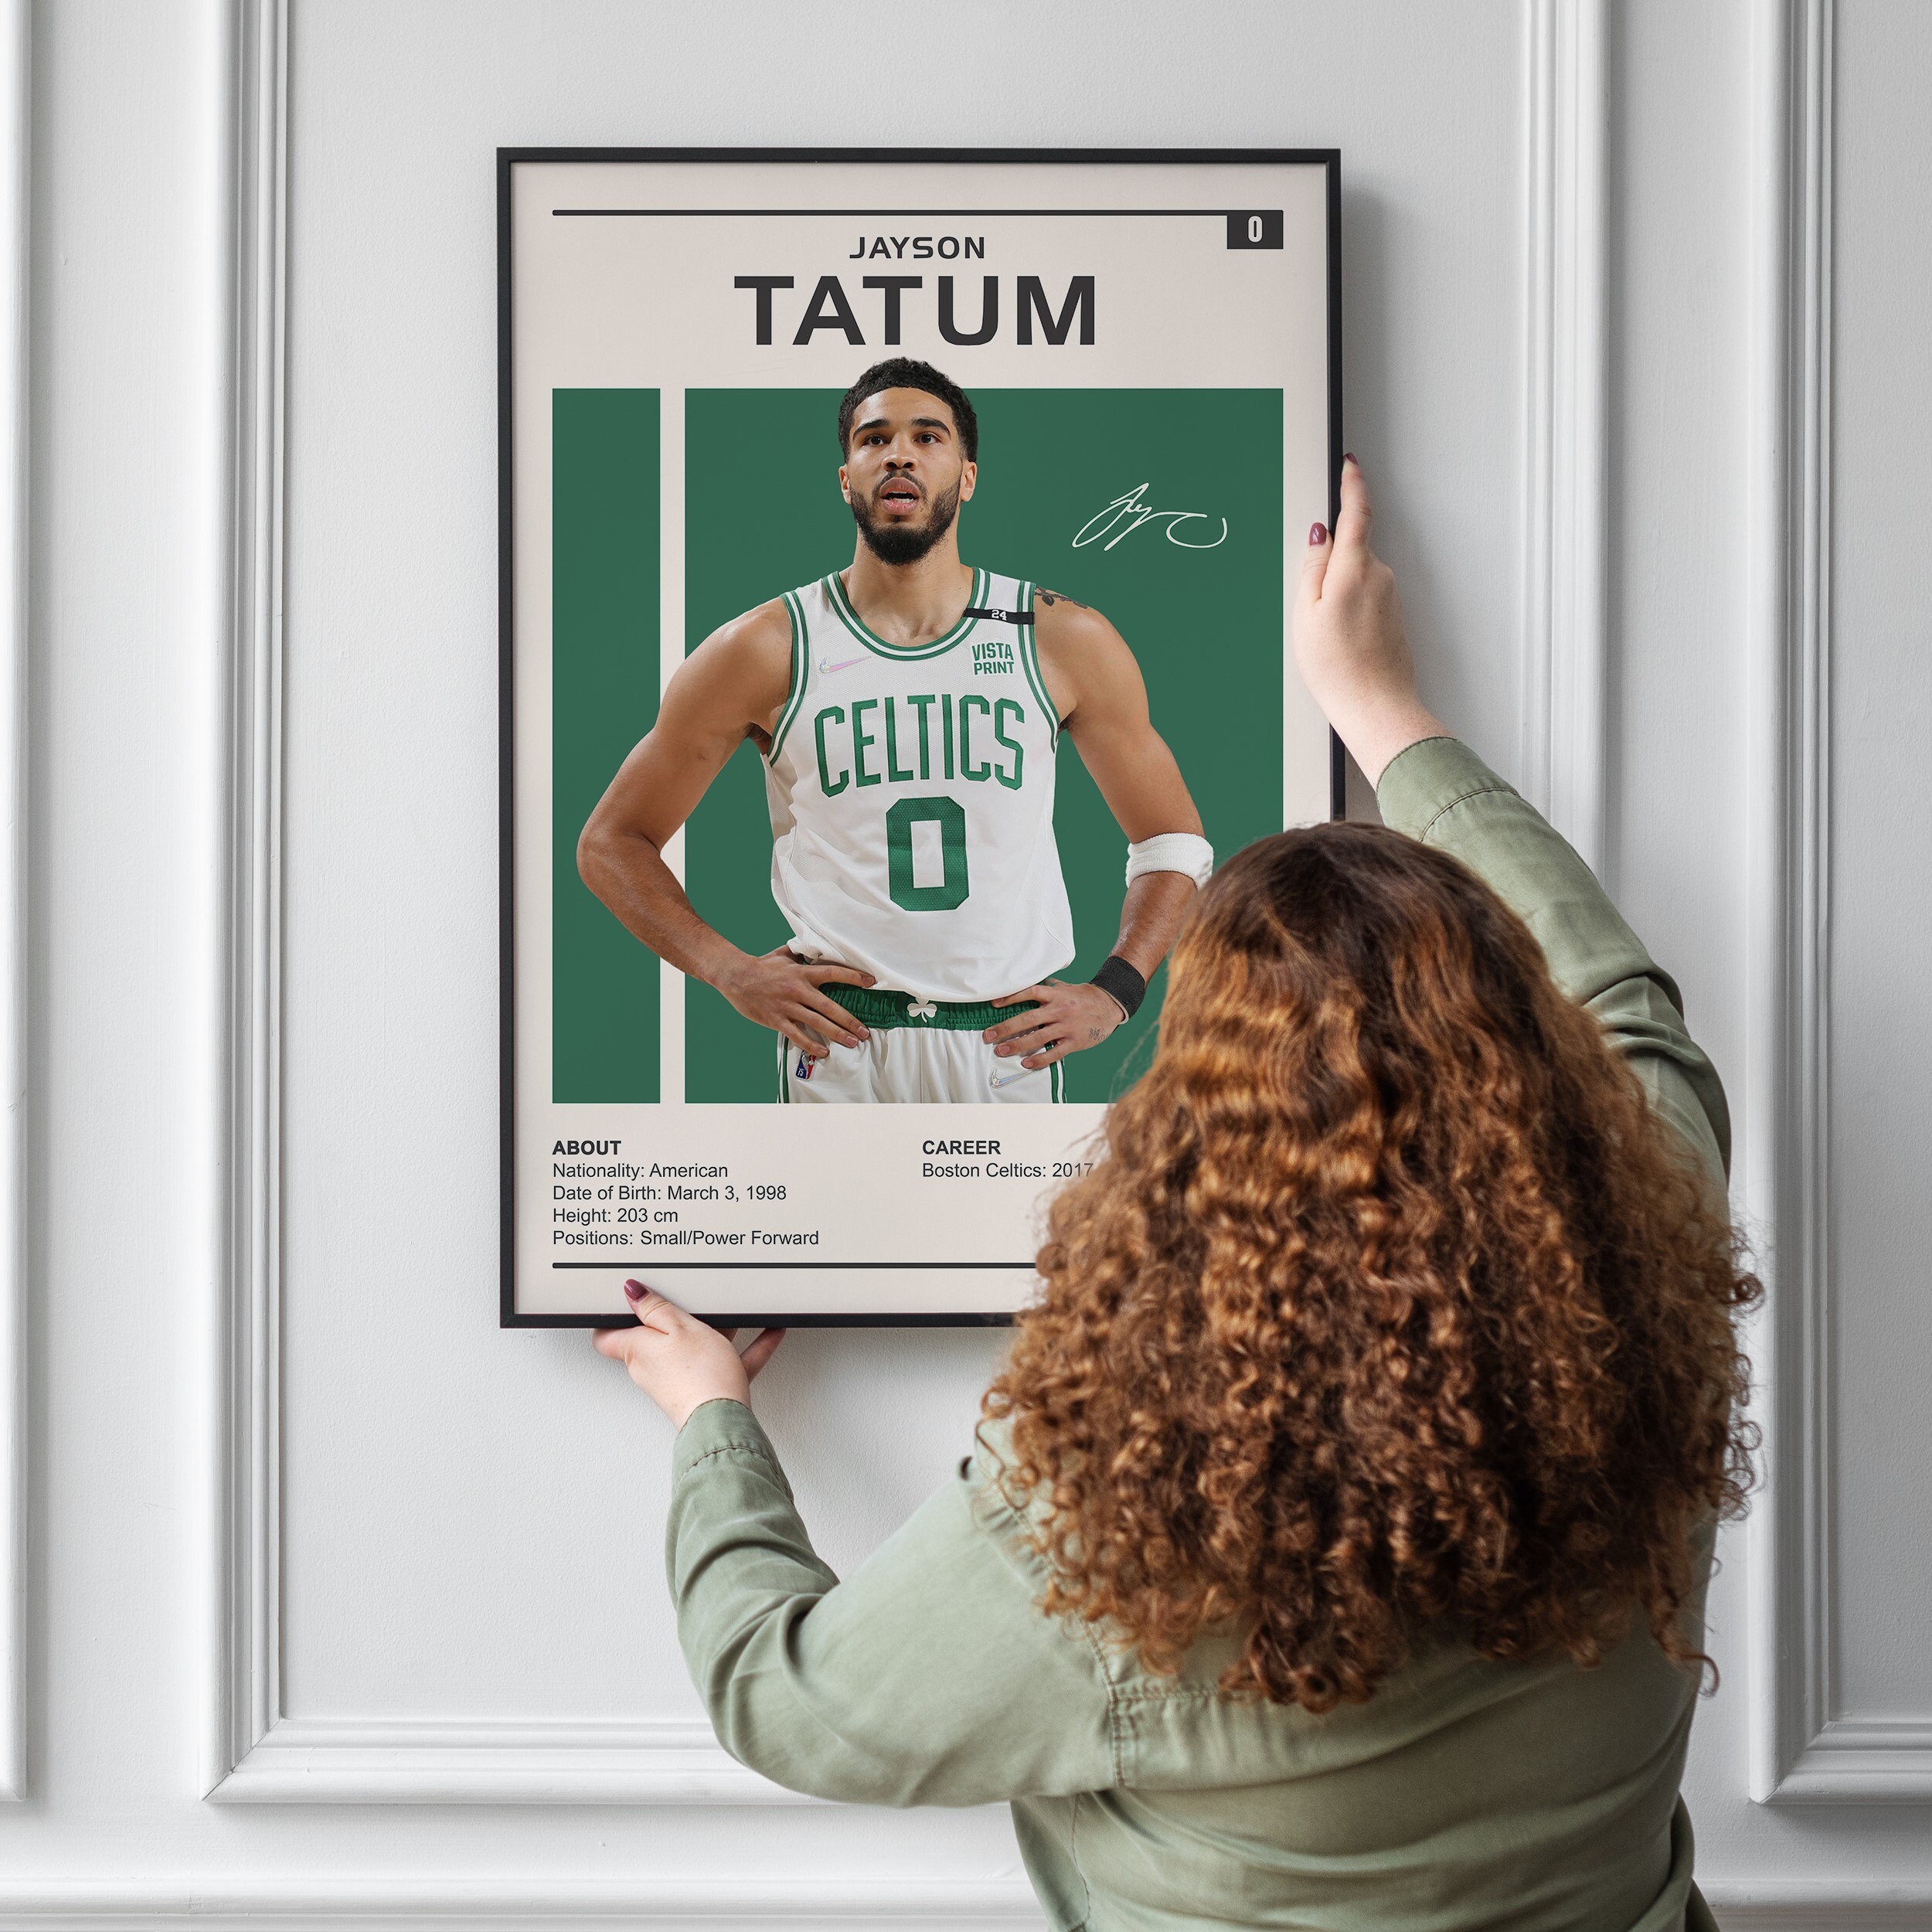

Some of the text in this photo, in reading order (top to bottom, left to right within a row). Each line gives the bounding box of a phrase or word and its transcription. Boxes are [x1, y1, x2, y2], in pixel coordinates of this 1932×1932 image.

[1249, 216, 1263, 243] 0
[849, 236, 985, 260] JAYSON
[733, 275, 1096, 346] TATUM
[991, 609, 1007, 621] 24
[971, 642, 1014, 662] VISTA
[973, 661, 1015, 675] PRINT
[815, 694, 1025, 798] CELTICS
[886, 796, 970, 912] 0
[553, 1140, 621, 1155] ABOUT
[922, 1140, 1002, 1155] CAREER
[553, 1162, 728, 1182] Nationality: American
[923, 1162, 980, 1178] Boston
[985, 1162, 1046, 1178] Celtics:
[553, 1185, 787, 1202] Date of Birth: March 3, 1998
[553, 1207, 679, 1226] Height: 203 cm
[553, 1230, 819, 1245] Positions: Small/Power Forward
